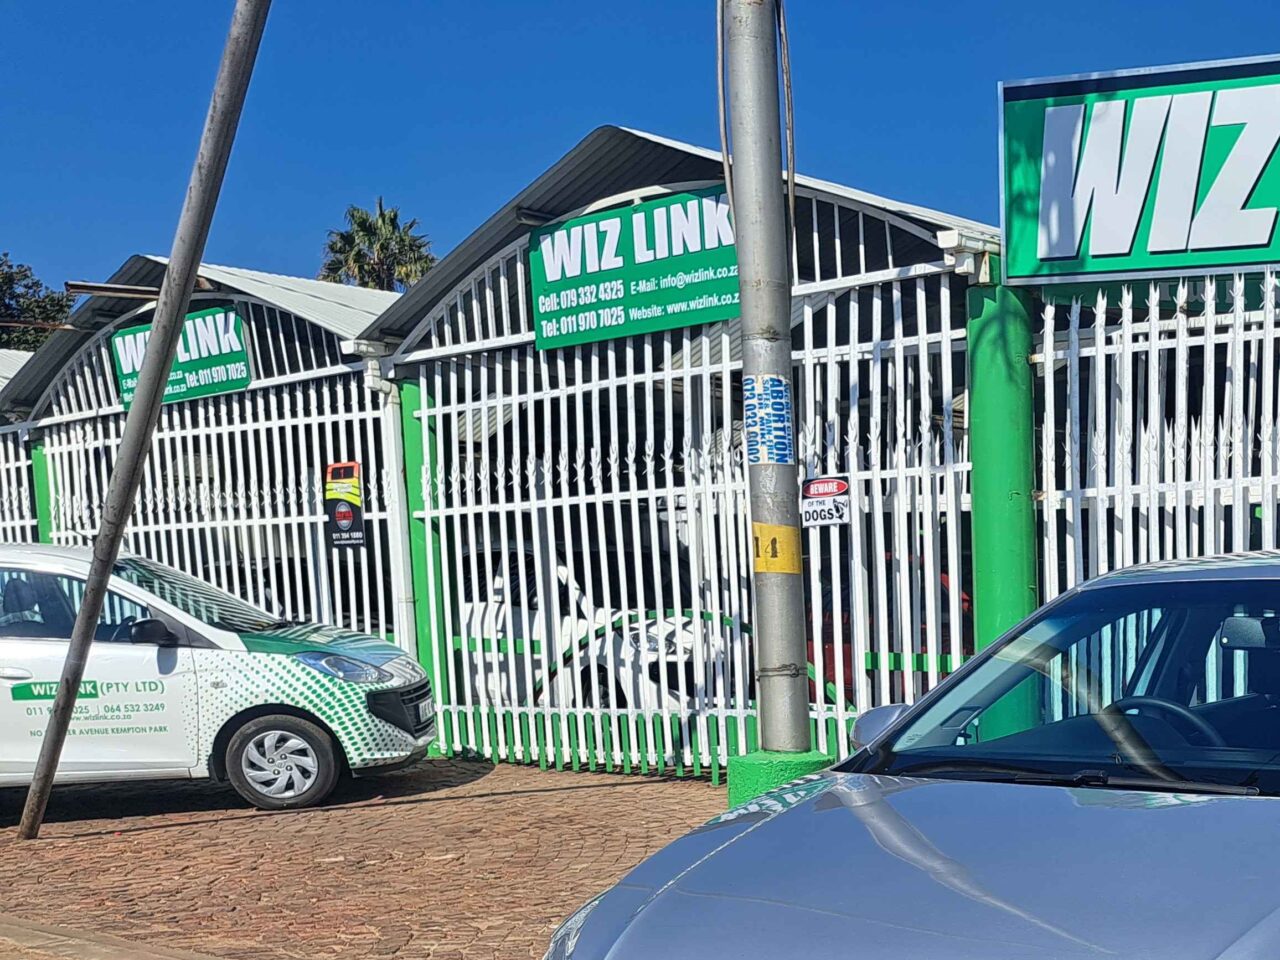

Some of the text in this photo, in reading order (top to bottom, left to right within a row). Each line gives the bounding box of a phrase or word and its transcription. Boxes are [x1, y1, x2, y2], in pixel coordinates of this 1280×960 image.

[539, 193, 735, 282] WIZ LINK
[538, 280, 624, 313] Cell: 079 332 4325
[630, 277, 659, 295] E-Mail:
[629, 292, 740, 320] Website: www.wizlink.co.z
[541, 306, 625, 338] Tel: 011 970 7025
[177, 311, 242, 362] LINK
[759, 416, 767, 447] MIKE
[769, 377, 788, 464] ABORTION
[810, 482, 838, 495] BEWARE
[805, 508, 834, 522] DOGS
[100, 681, 129, 696] (PTY
[135, 680, 165, 695] LTD)
[26, 706, 43, 716] 011
[103, 702, 165, 713] 064 532 3249
[111, 726, 148, 735] KEMPTON
[149, 725, 168, 733] PARK
